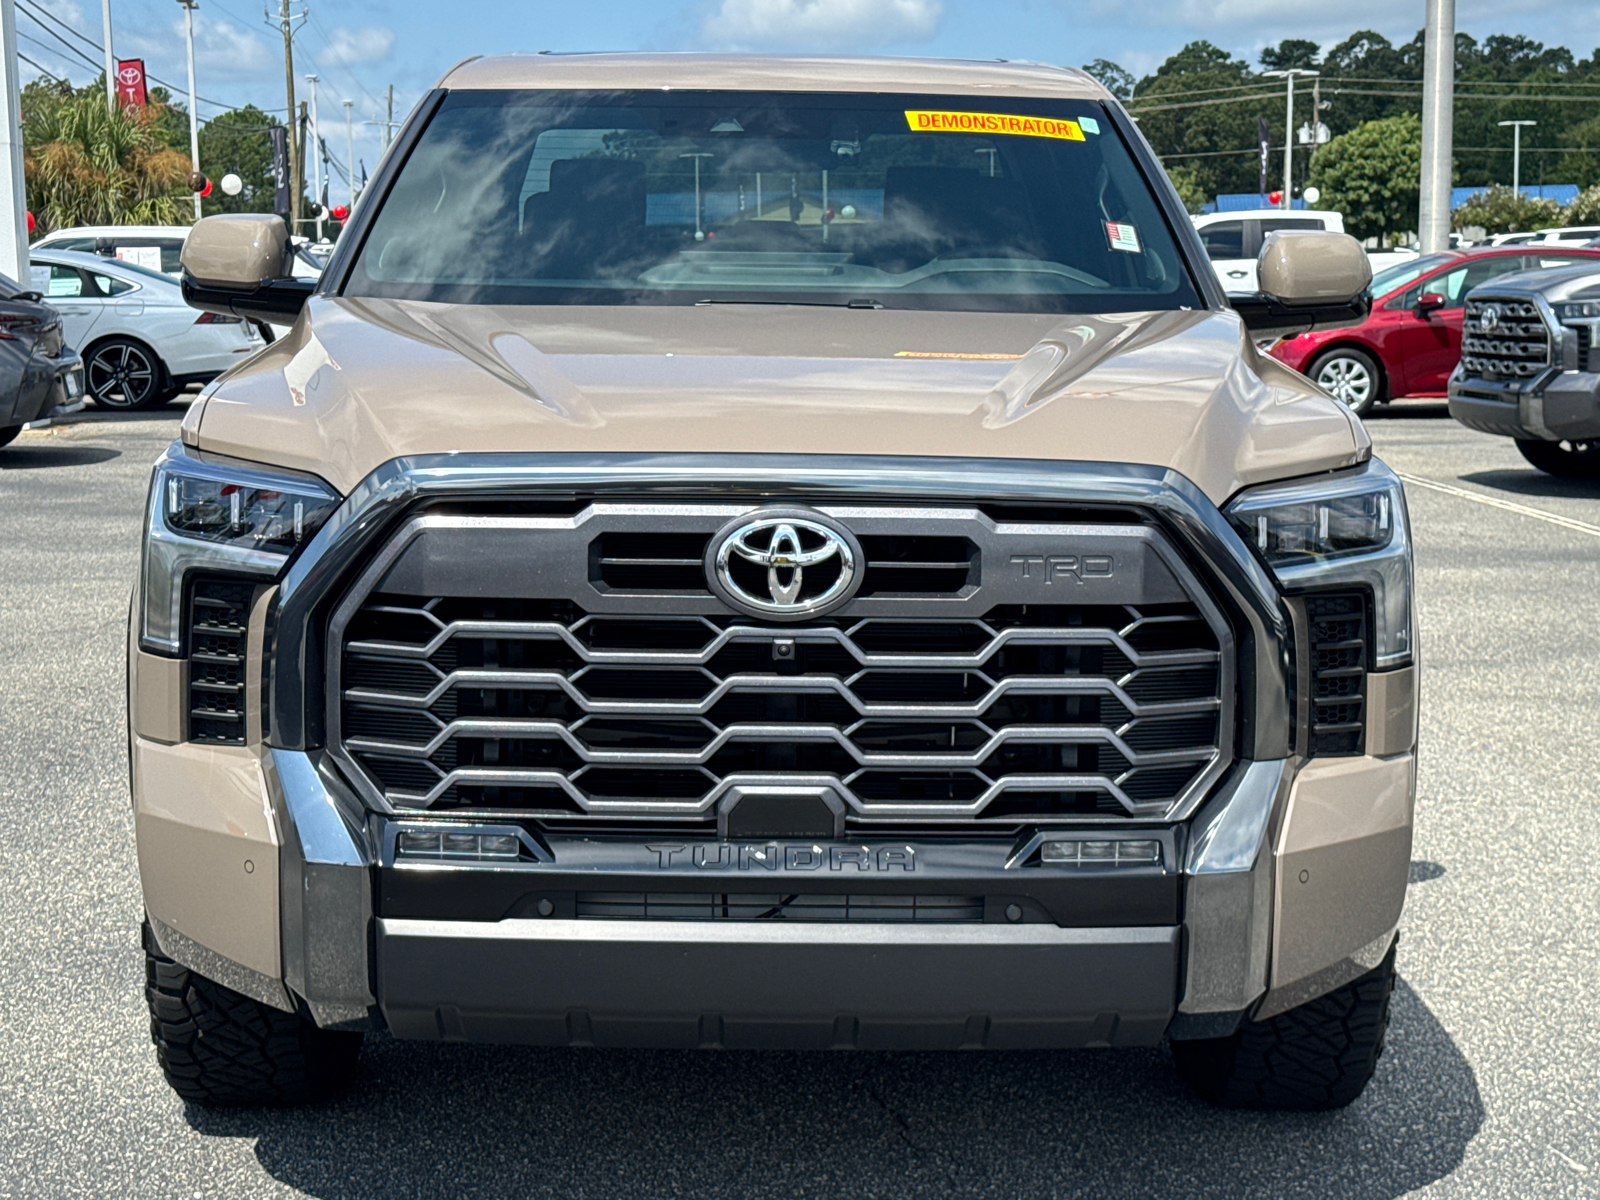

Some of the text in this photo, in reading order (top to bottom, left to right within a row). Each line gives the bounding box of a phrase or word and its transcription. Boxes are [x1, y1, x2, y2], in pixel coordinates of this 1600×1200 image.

[918, 113, 1073, 137] DEMONSTRATOR
[1009, 554, 1115, 585] TRD
[645, 843, 917, 872] TUNDRA
